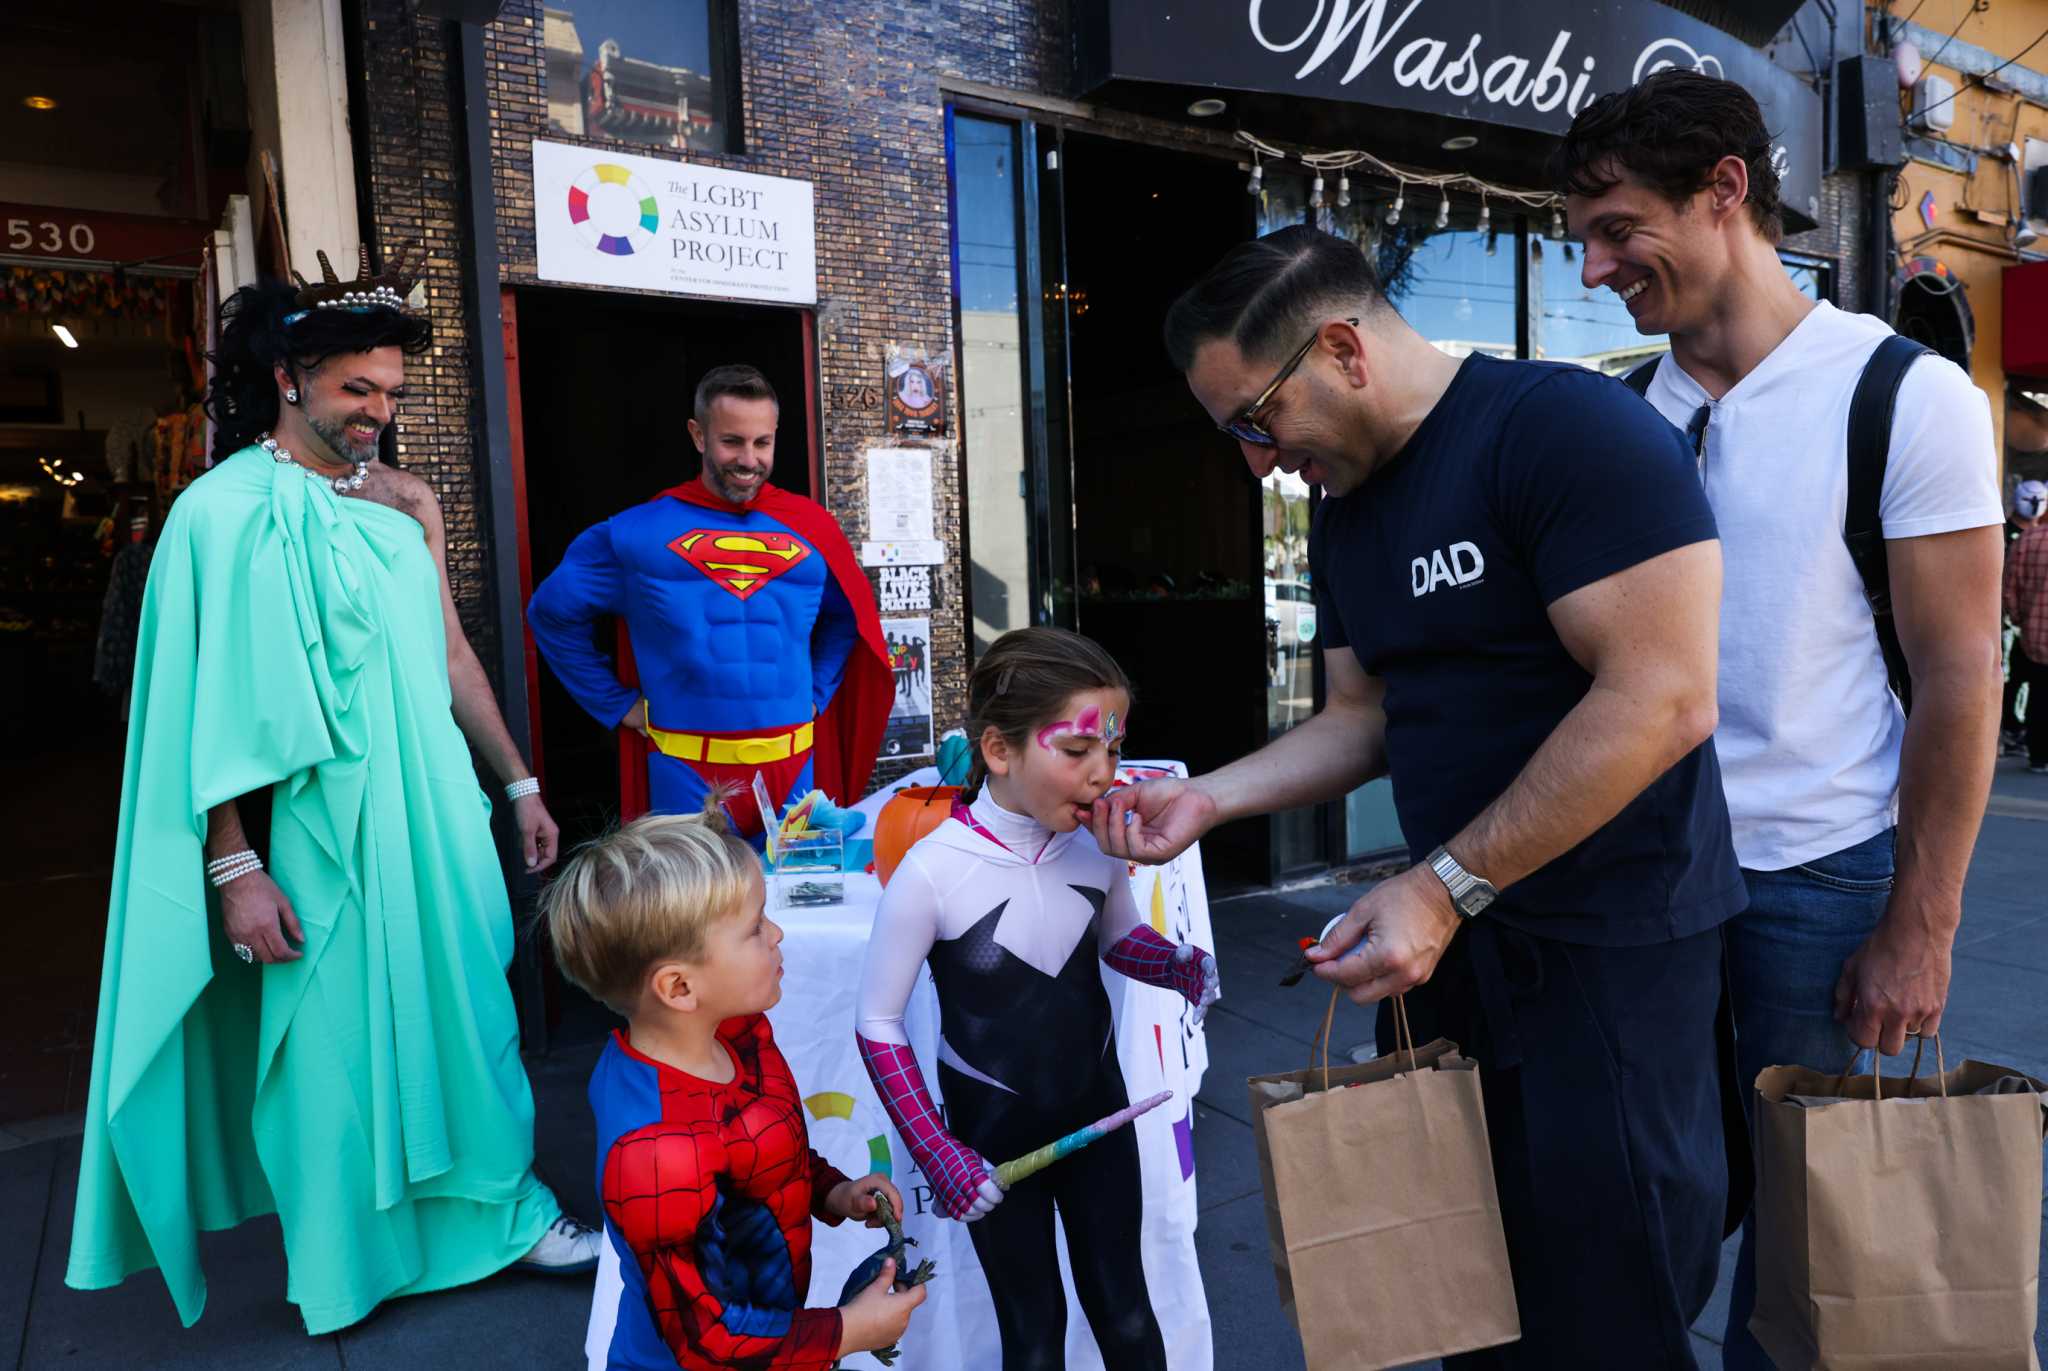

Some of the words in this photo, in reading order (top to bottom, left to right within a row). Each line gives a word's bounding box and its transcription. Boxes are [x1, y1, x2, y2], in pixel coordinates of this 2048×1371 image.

[1249, 0, 1597, 118] Wasabi
[668, 181, 688, 194] The
[692, 182, 763, 210] LGBT
[8, 218, 95, 254] 530
[670, 208, 779, 241] ASYLUM
[671, 238, 789, 271] PROJECT
[879, 566, 930, 582] BLACK
[1411, 541, 1485, 598] DAD
[879, 581, 931, 598] LIVES
[880, 597, 931, 611] MATTER
